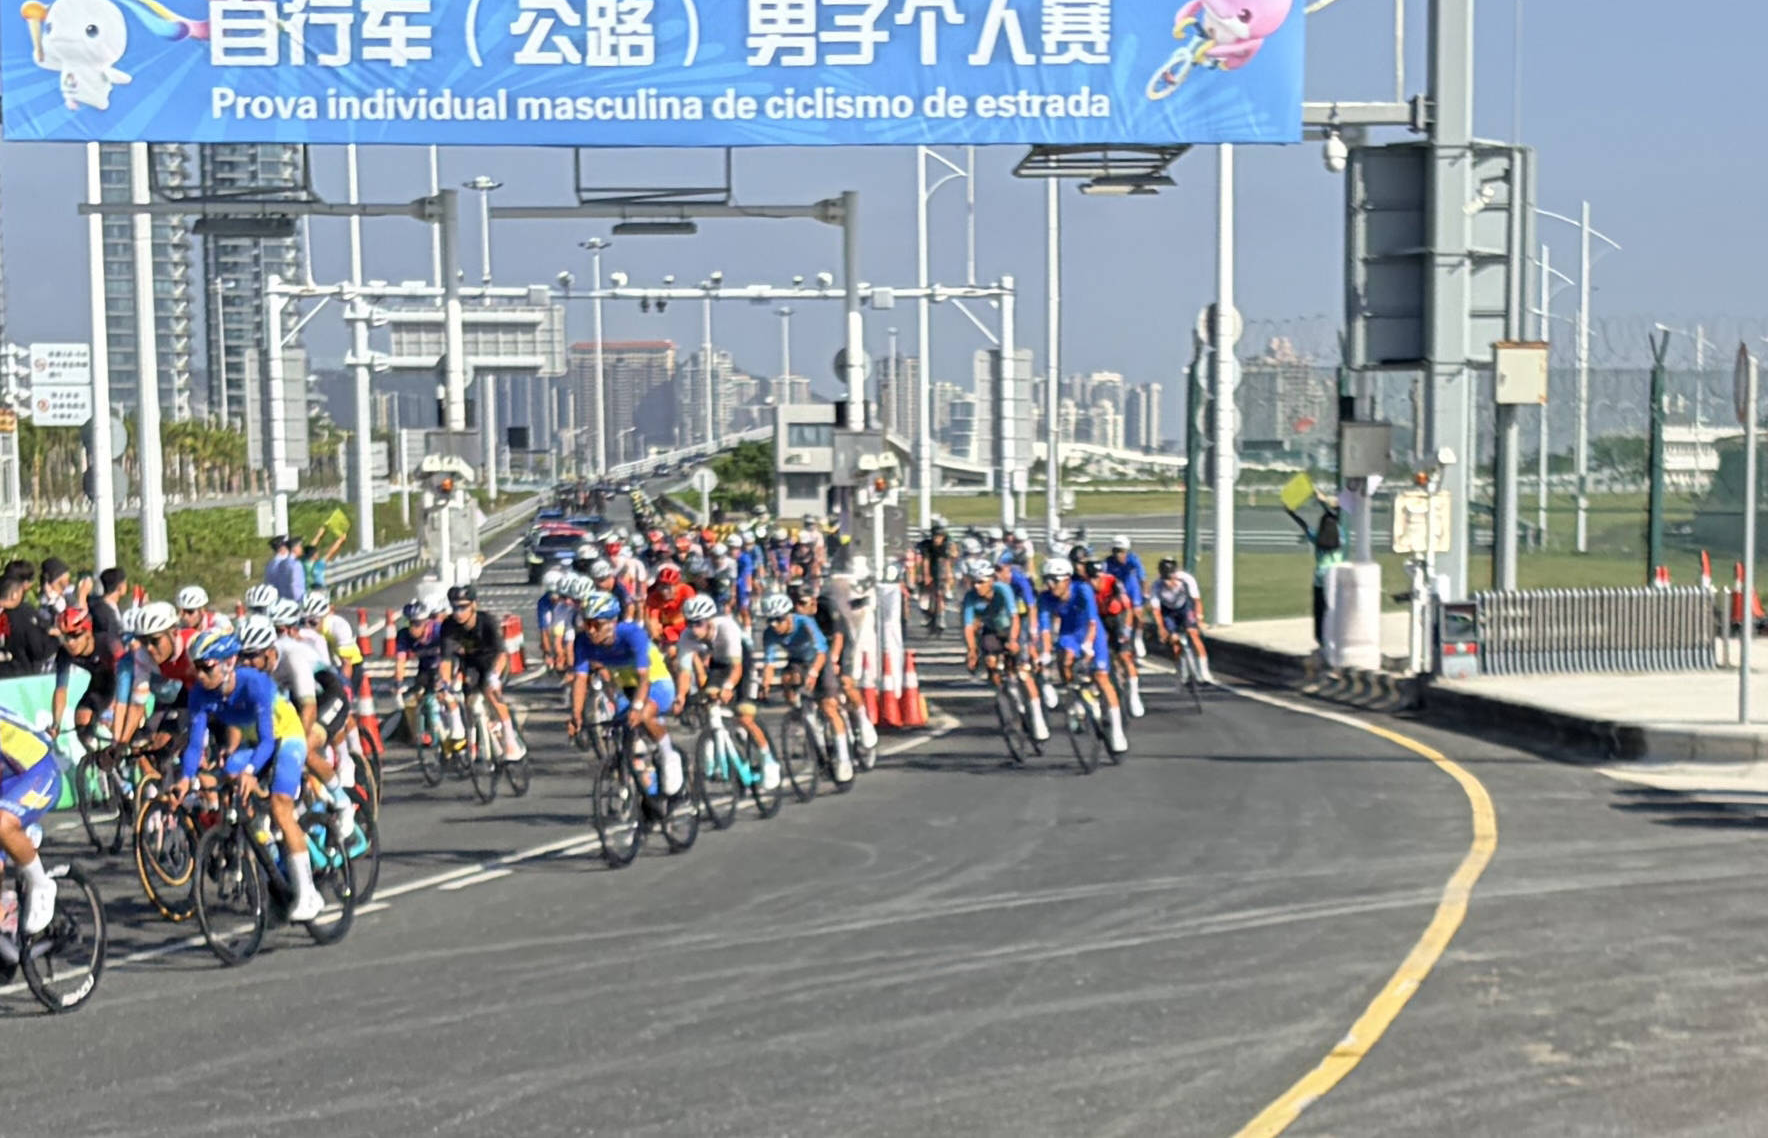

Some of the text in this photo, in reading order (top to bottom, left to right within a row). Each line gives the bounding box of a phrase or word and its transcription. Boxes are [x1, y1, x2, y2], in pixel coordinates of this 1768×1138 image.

[212, 86, 1110, 121] Prova individual masculina de ciclismo de estrada
